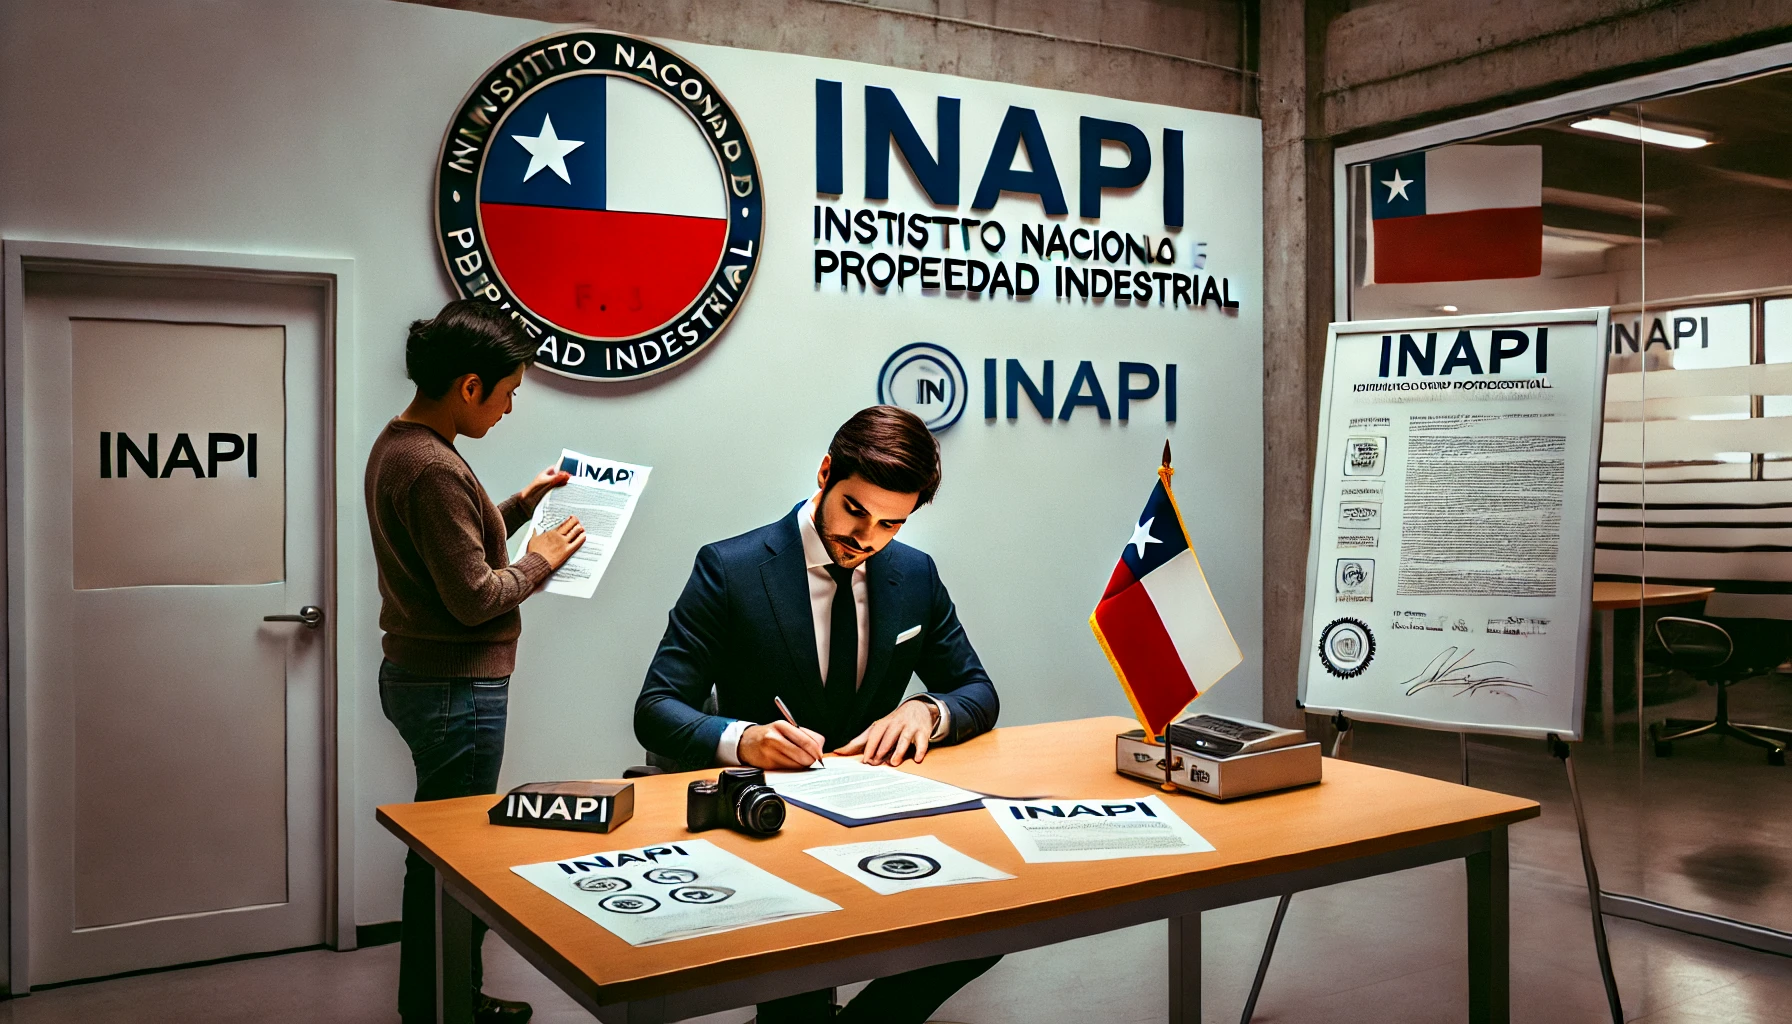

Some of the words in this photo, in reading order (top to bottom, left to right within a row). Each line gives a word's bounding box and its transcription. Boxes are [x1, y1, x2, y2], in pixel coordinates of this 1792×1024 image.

[815, 78, 1185, 228] INAPI
[1055, 265, 1239, 309] INDESTRIAL
[1379, 327, 1549, 378] INAPI
[983, 358, 1177, 423] INAPI
[100, 431, 258, 479] INAPI
[506, 794, 608, 823] INAPI
[1009, 792, 1158, 820] INAPI
[557, 845, 690, 875] INAPI
